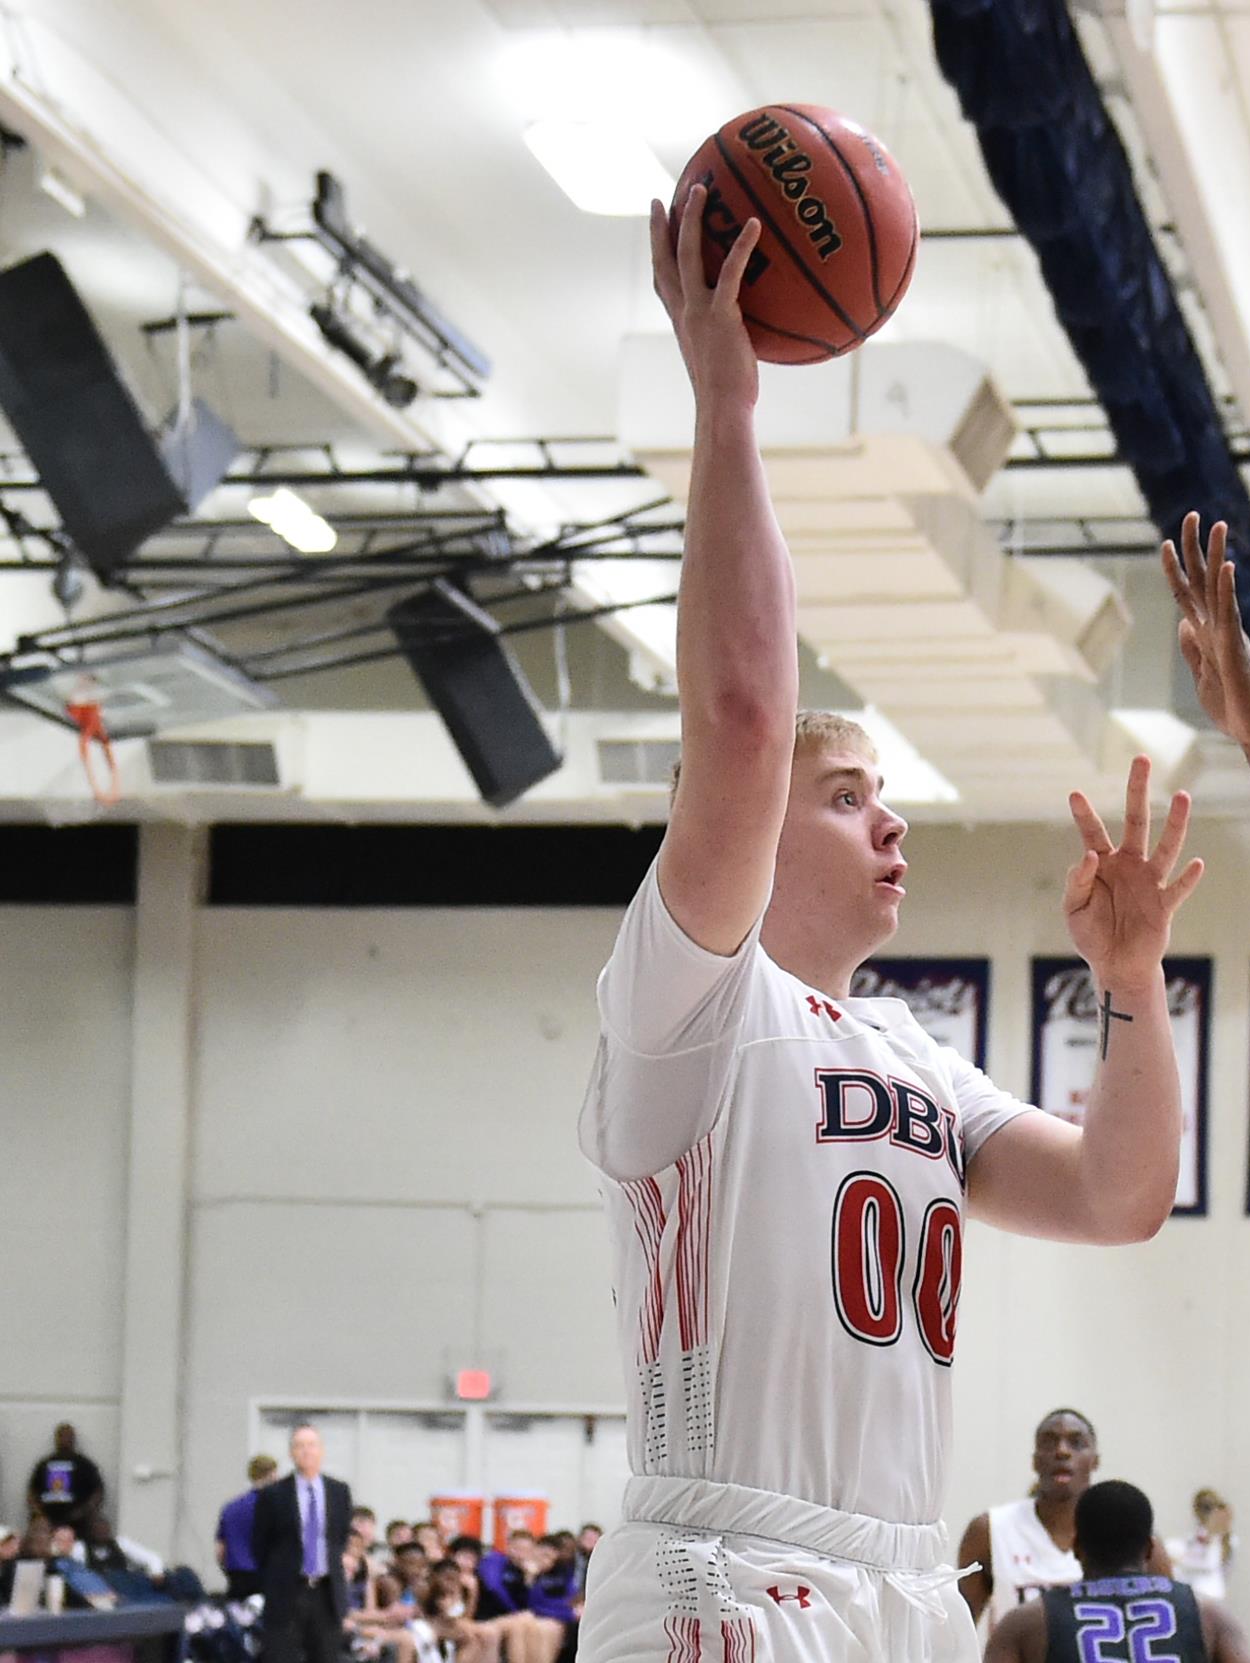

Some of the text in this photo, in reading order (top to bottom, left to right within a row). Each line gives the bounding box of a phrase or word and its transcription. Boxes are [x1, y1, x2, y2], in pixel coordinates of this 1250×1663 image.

[738, 113, 843, 263] Wilson
[832, 1170, 962, 1366] 00
[1074, 1598, 1181, 1663] 22
